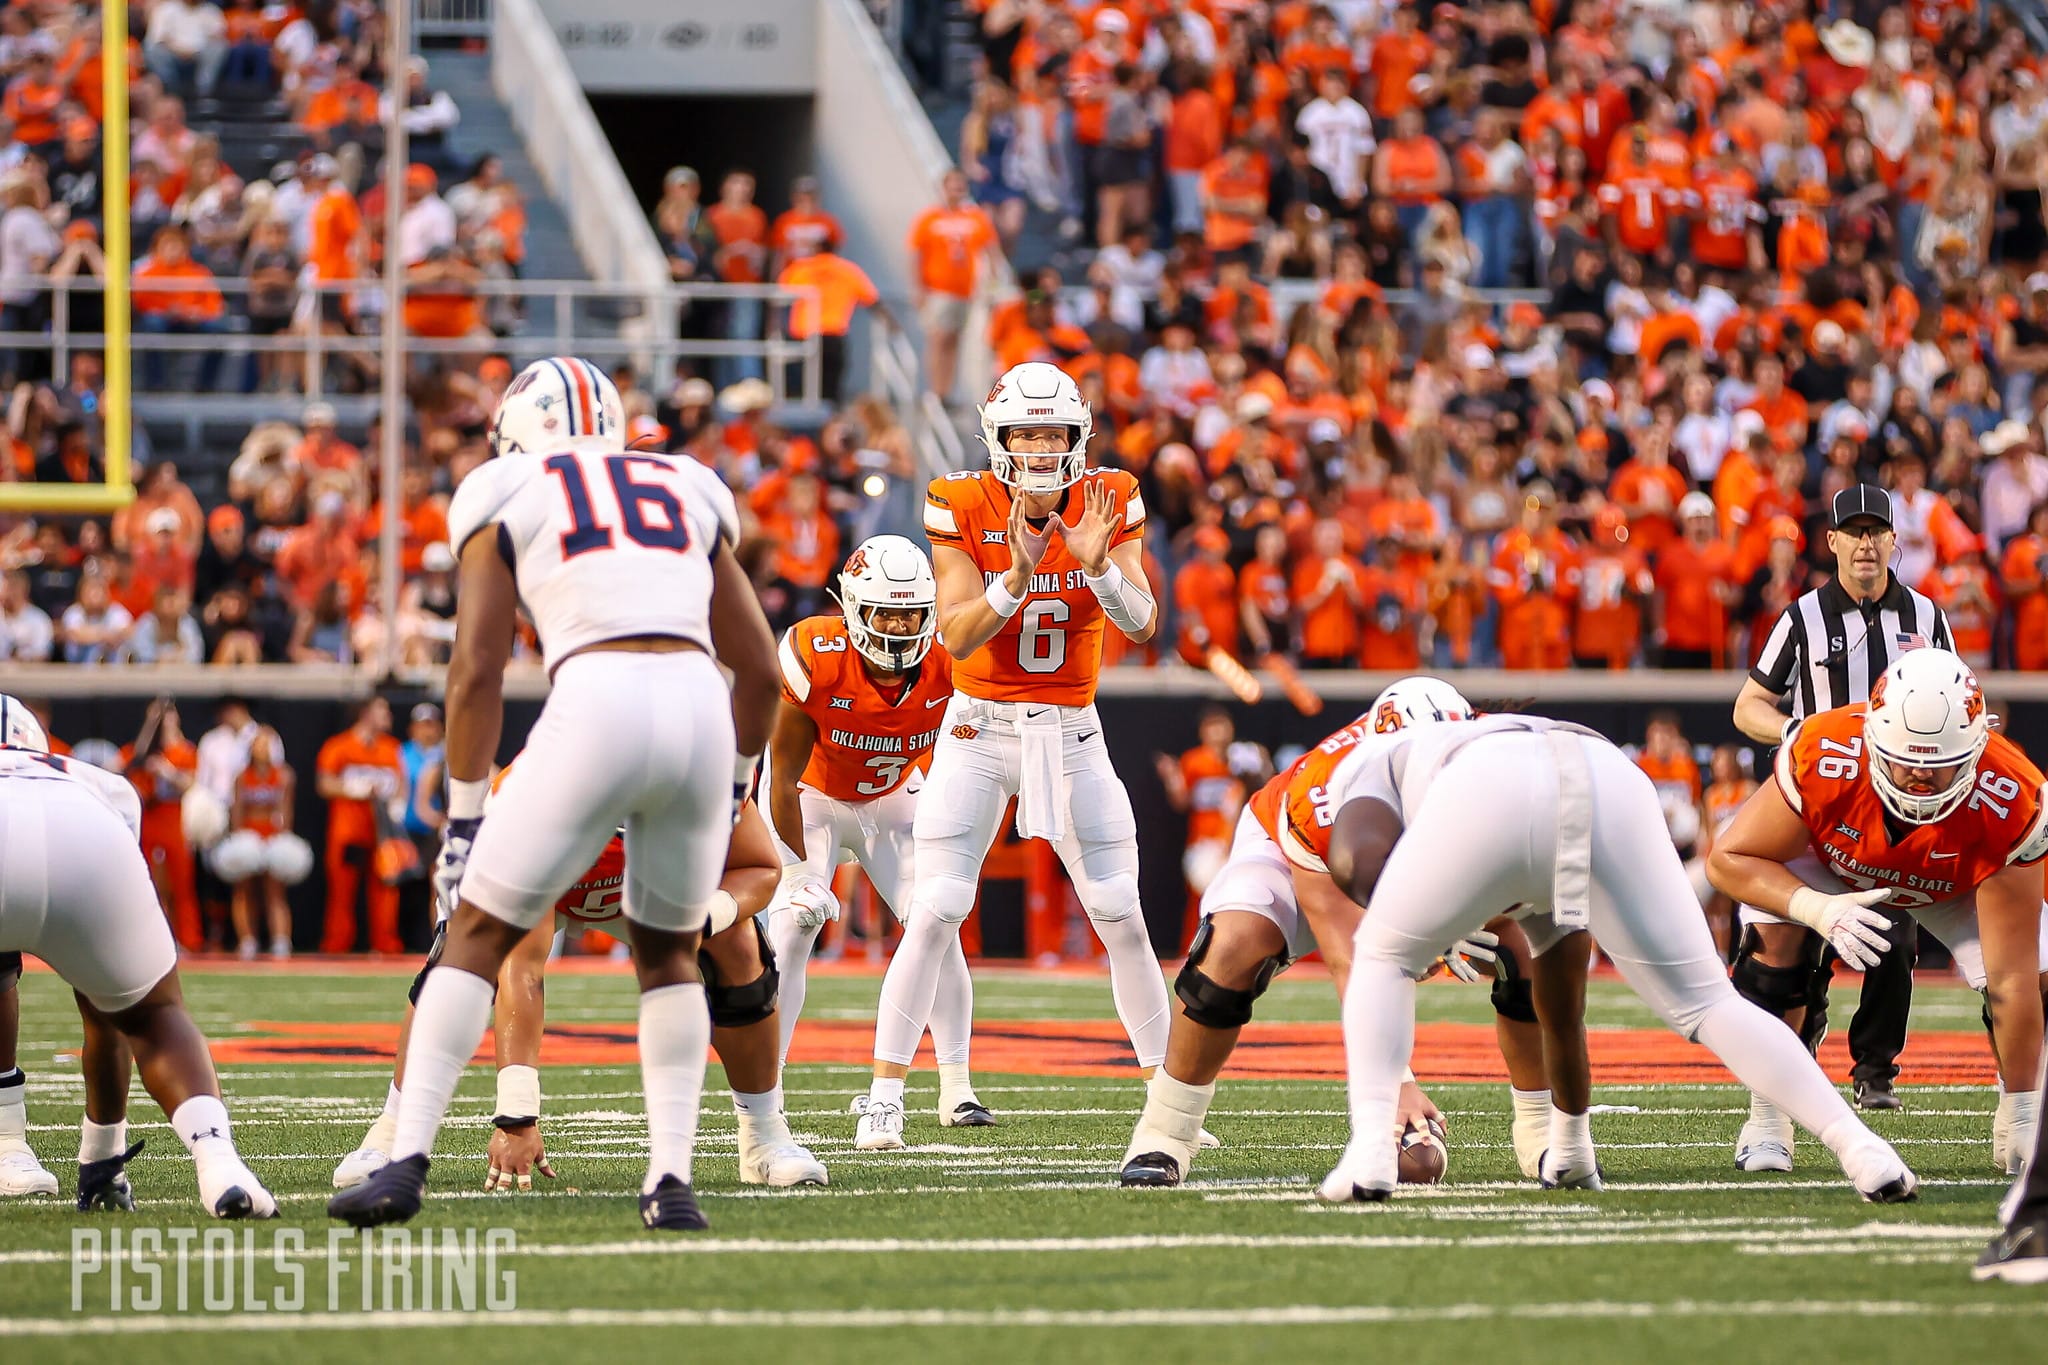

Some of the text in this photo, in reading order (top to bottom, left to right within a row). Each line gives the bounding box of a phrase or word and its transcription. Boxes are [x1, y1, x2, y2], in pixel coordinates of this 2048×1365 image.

[543, 451, 692, 562] 16
[982, 530, 1006, 544] XII
[812, 635, 847, 653] 3
[1018, 599, 1070, 673] 6
[1831, 636, 1843, 652] S
[831, 729, 902, 753] OKLAHOMA
[1818, 736, 1863, 780] 76
[1908, 744, 1938, 754] COWBOYS
[856, 755, 909, 795] 3
[1968, 770, 2020, 820] 76
[1823, 842, 1954, 893] OKLAHOMA STATE
